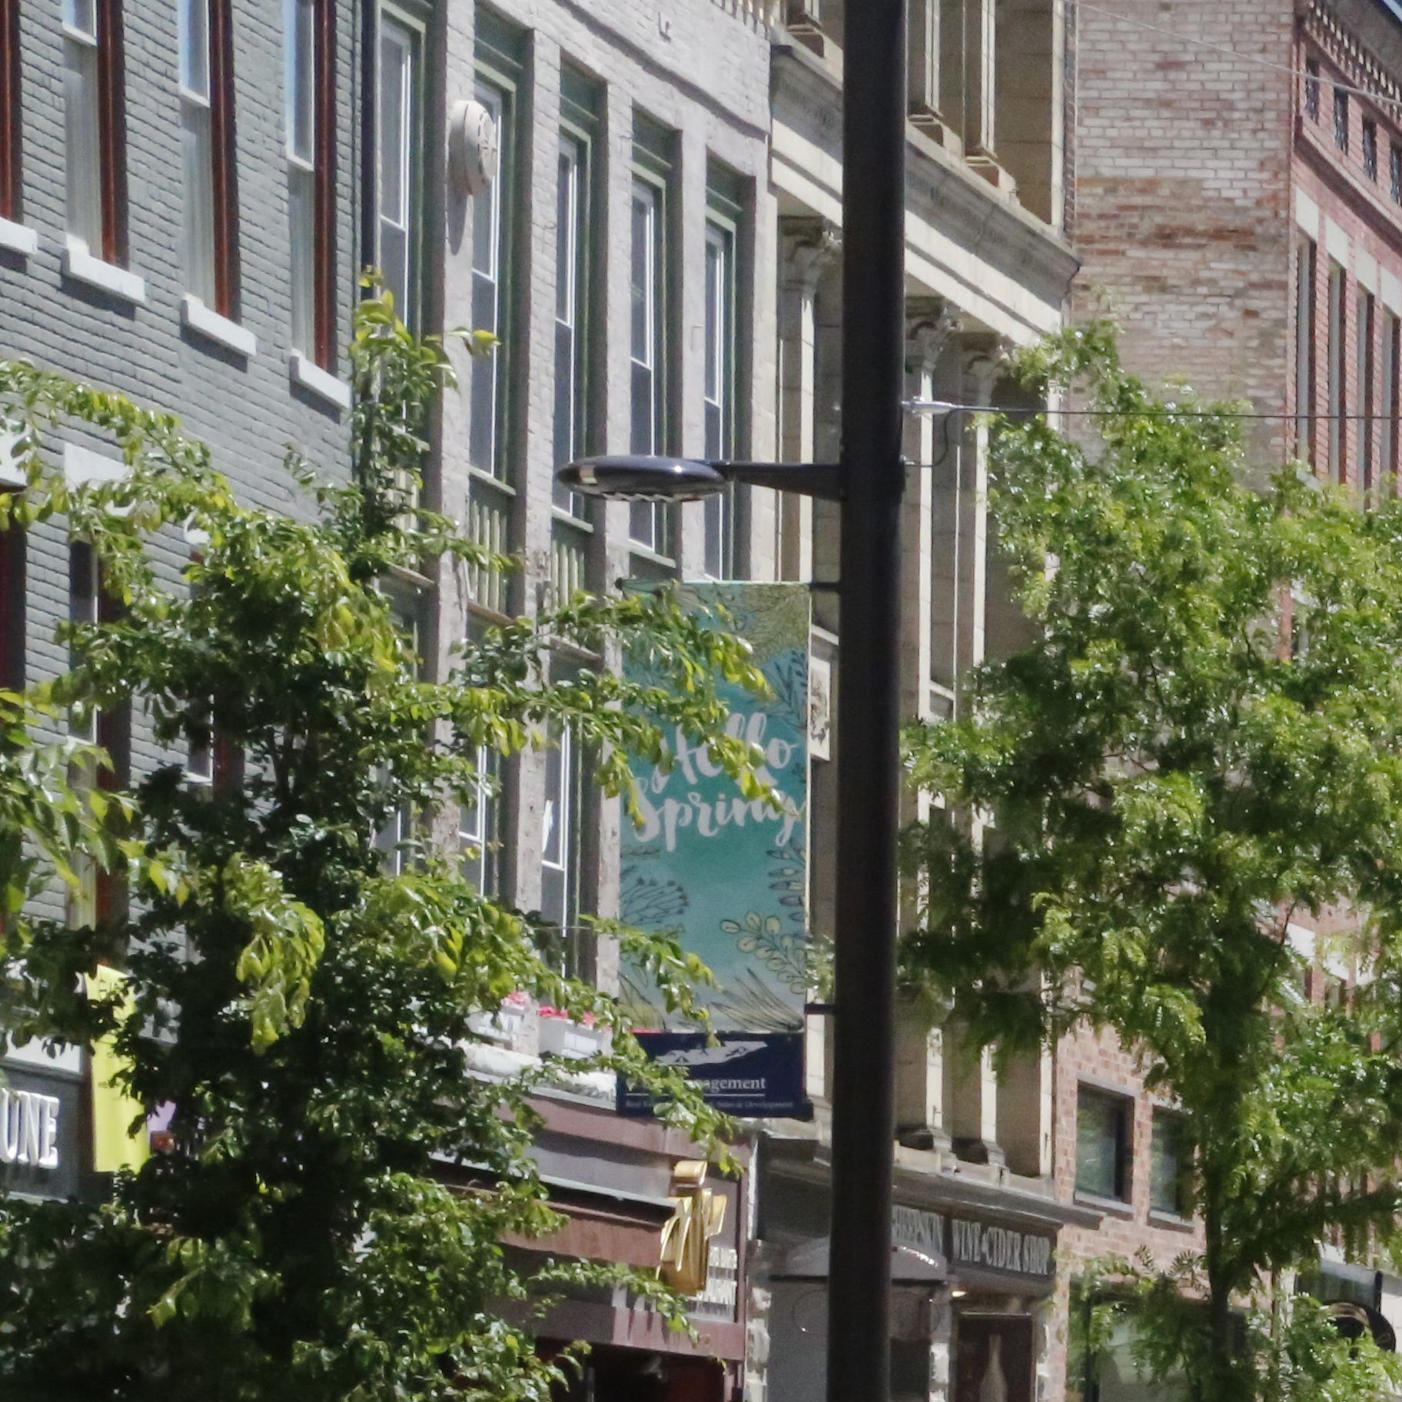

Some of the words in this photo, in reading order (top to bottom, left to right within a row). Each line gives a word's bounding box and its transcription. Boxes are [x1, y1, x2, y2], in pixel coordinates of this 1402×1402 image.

[632, 777, 806, 853] Spring
[684, 1077, 767, 1095] agement
[952, 1219, 982, 1262] WINE
[986, 1226, 1022, 1272] CIDER
[1022, 1234, 1050, 1276] SHOP
